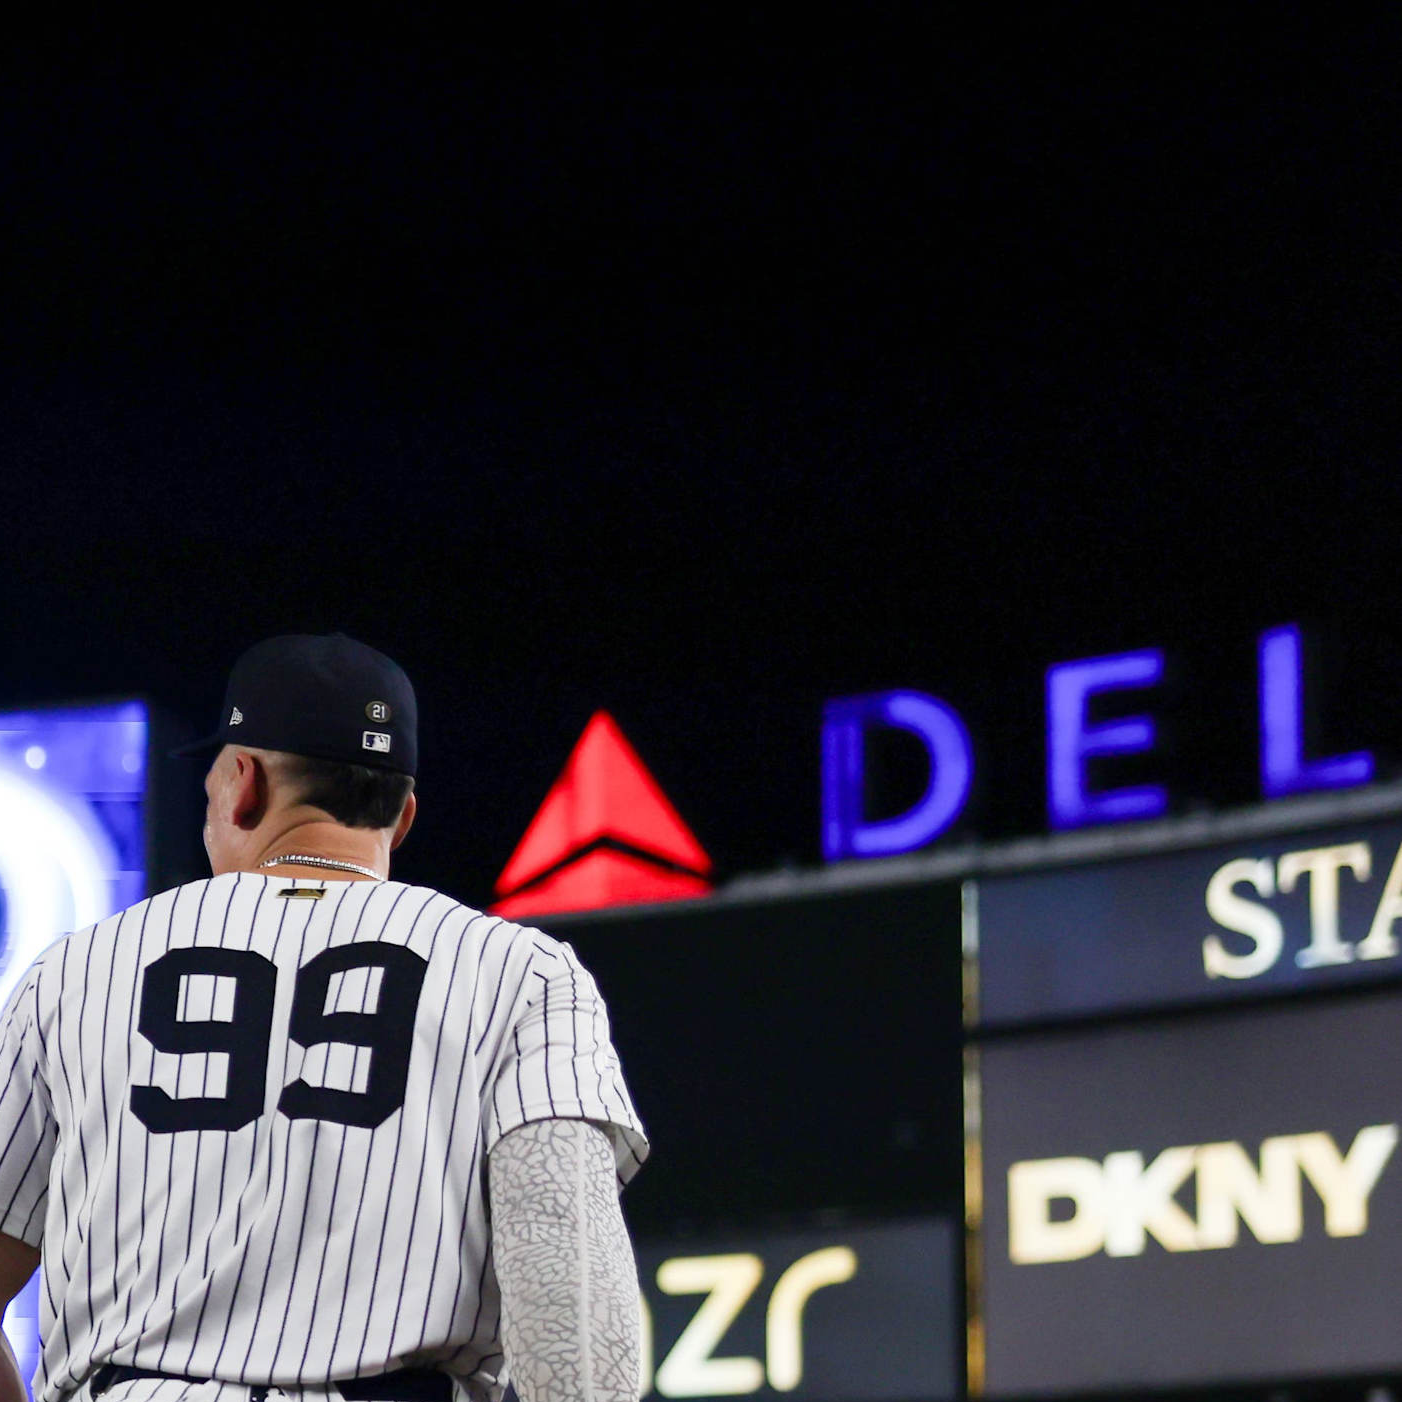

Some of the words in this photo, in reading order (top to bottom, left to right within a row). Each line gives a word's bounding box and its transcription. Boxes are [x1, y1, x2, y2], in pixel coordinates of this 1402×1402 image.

[372, 704, 385, 719] 21
[130, 941, 428, 1133] 99
[1008, 1124, 1397, 1265] DKNY
[640, 1246, 857, 1399] zr
